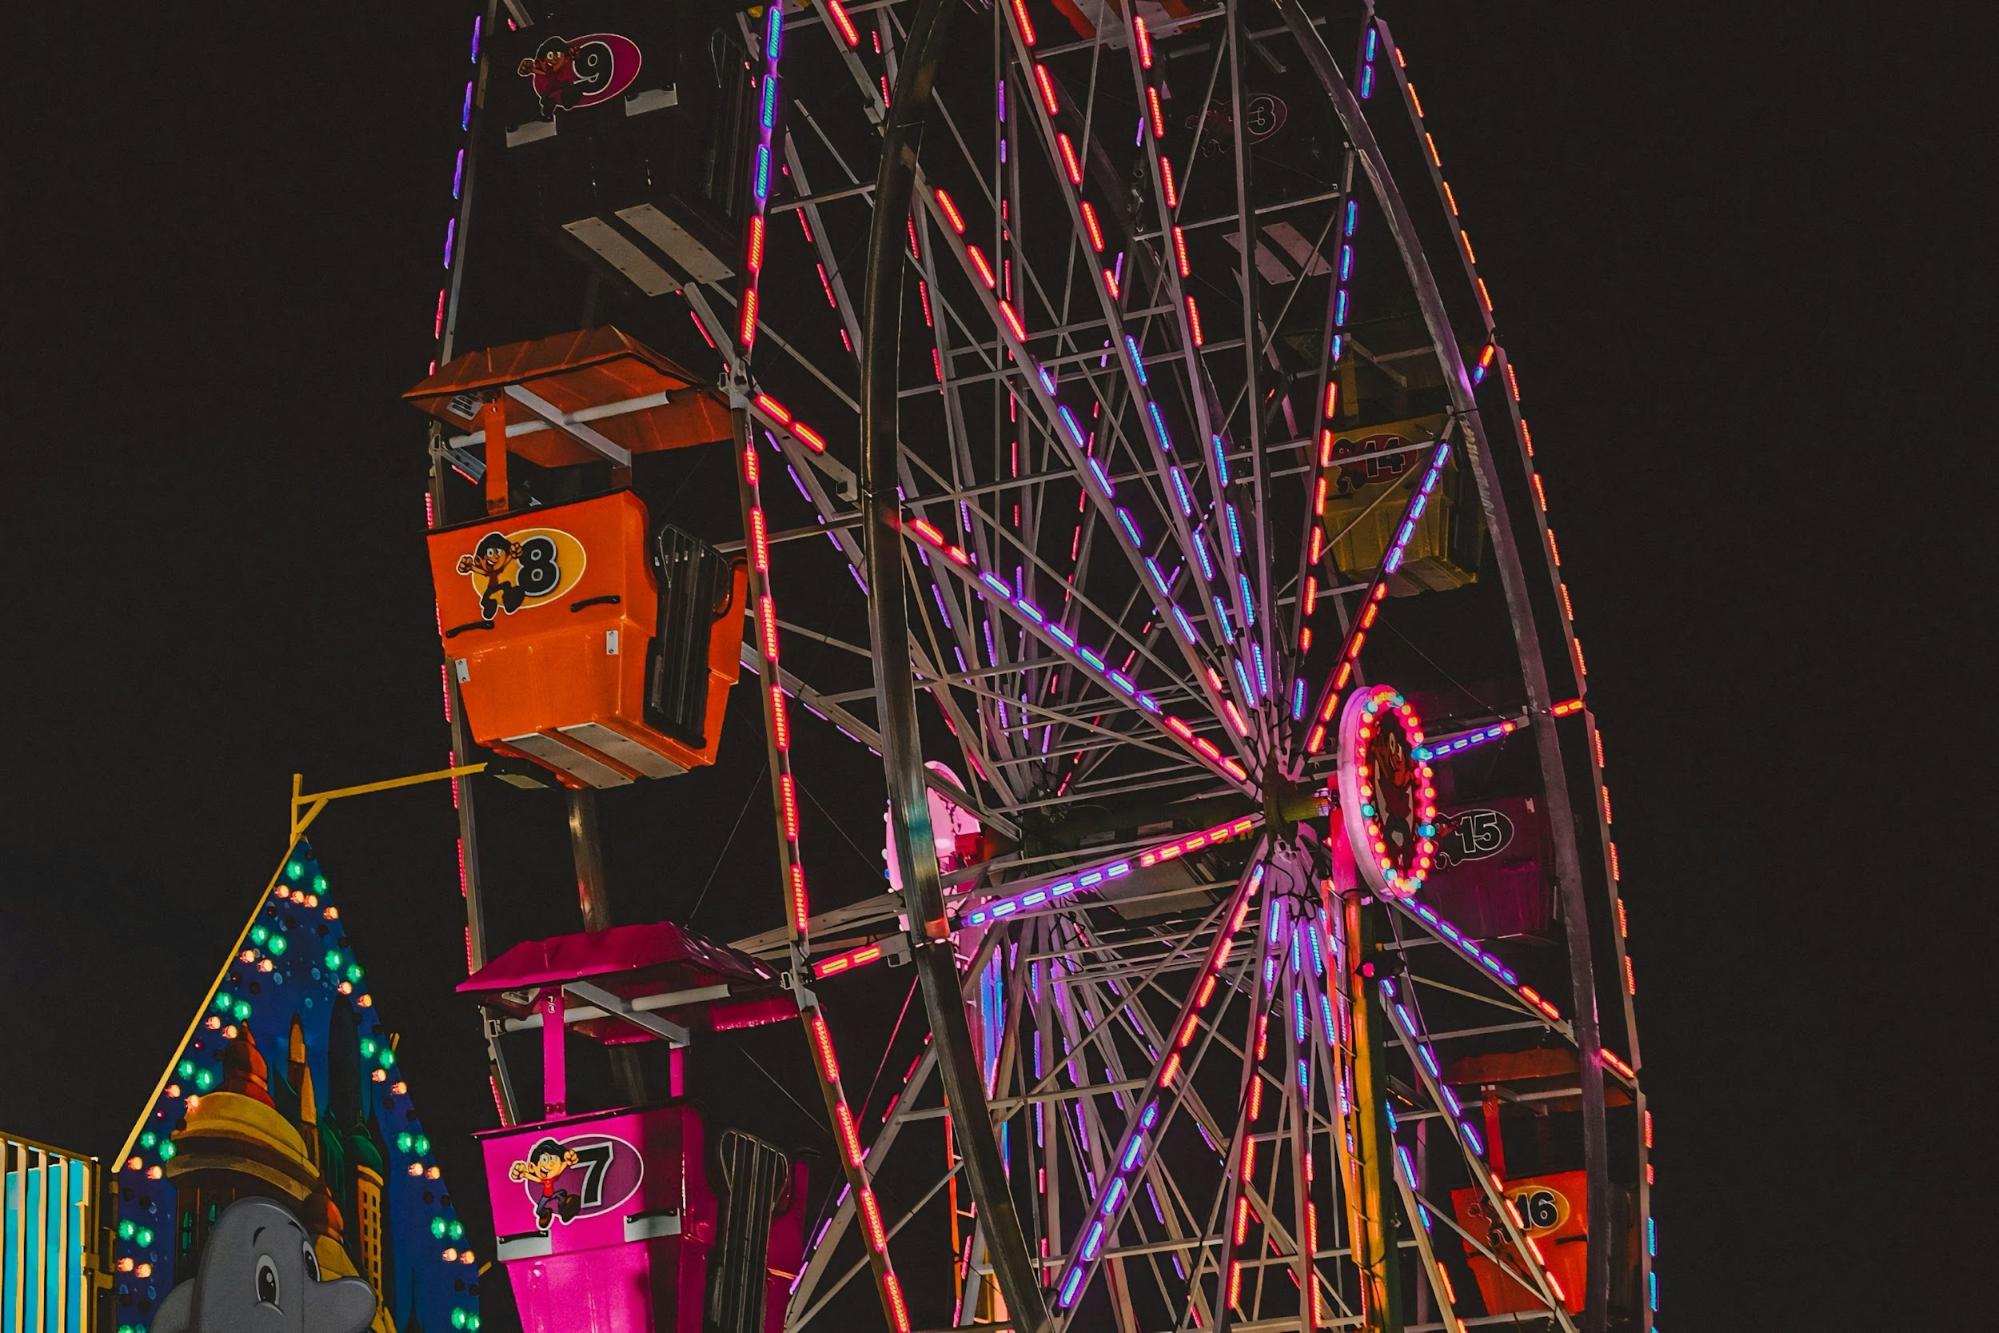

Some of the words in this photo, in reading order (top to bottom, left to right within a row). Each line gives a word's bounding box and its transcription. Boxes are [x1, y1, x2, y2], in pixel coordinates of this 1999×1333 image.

[573, 40, 614, 95] 9
[1247, 96, 1277, 135] 3
[1364, 437, 1406, 478] 14
[516, 535, 560, 596] 8
[1455, 812, 1502, 853] 15
[570, 1141, 614, 1209] 7
[1514, 1190, 1559, 1231] 16
